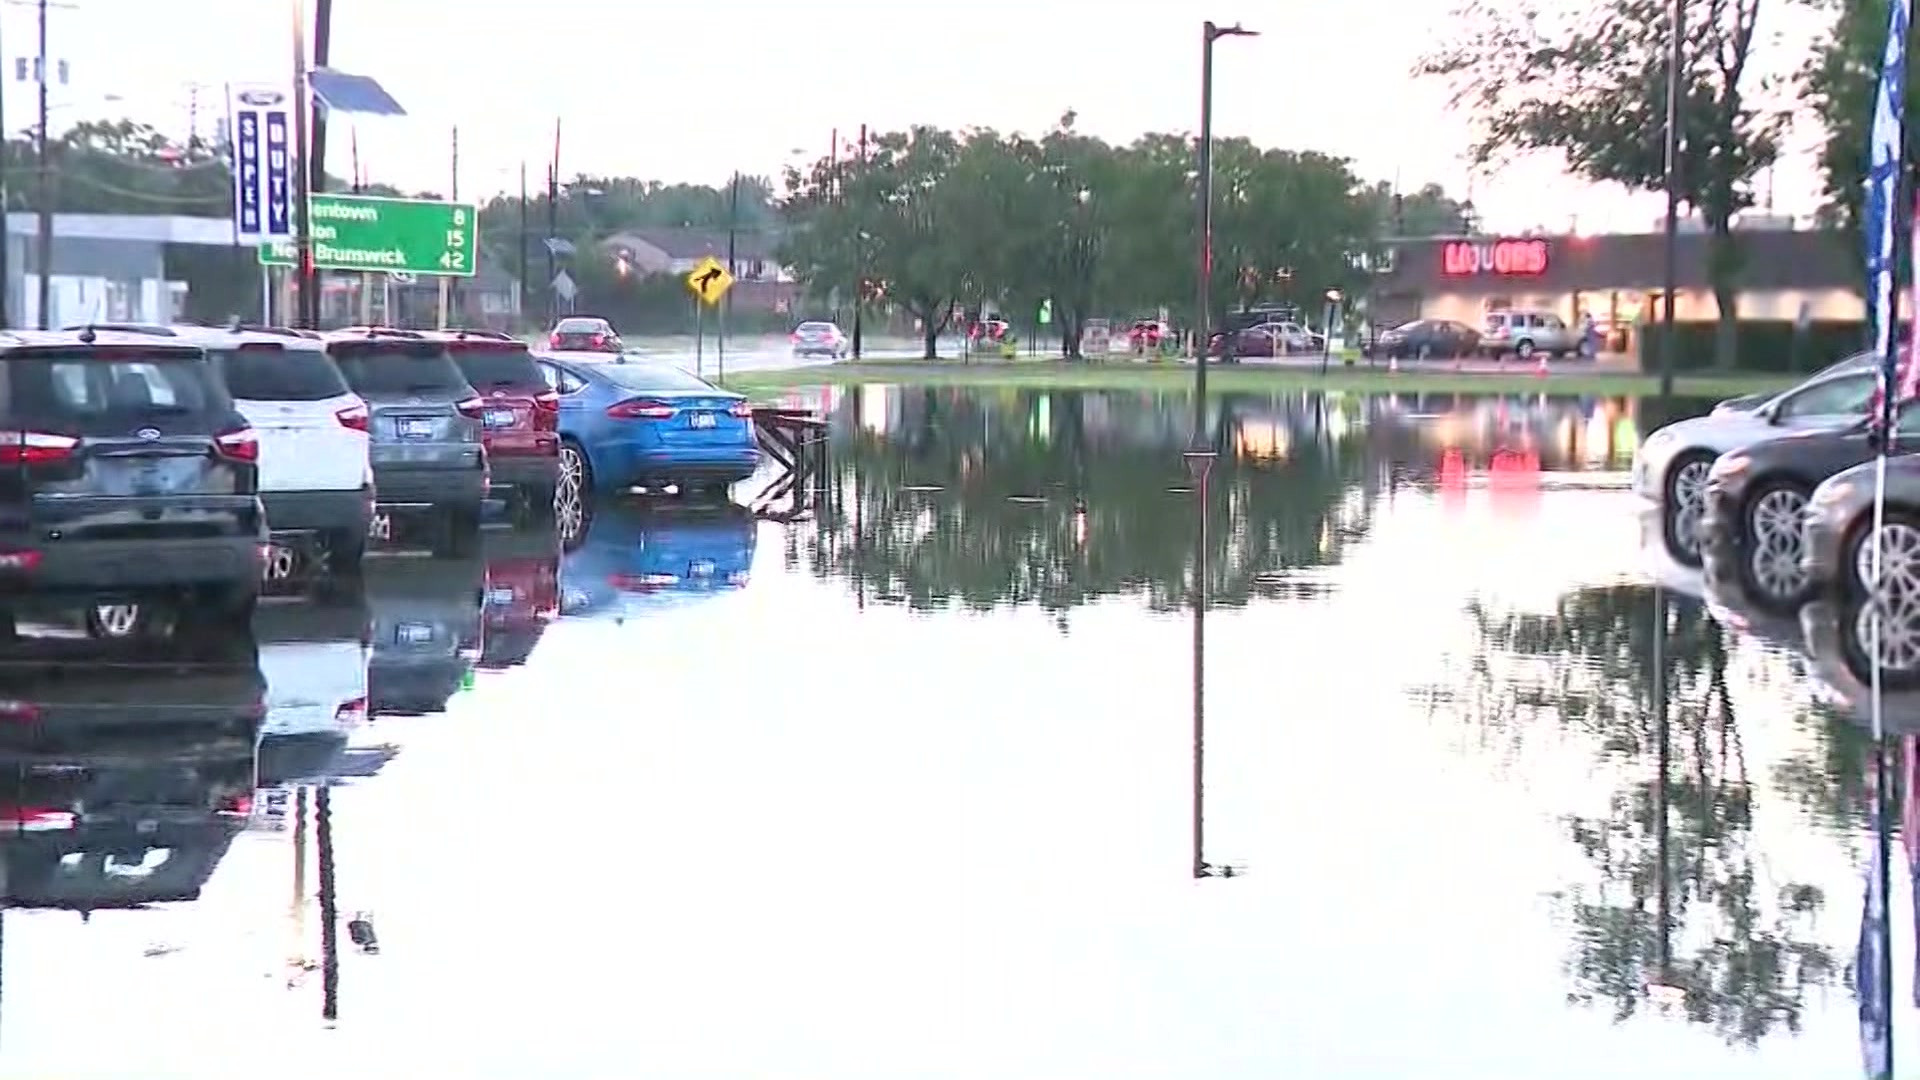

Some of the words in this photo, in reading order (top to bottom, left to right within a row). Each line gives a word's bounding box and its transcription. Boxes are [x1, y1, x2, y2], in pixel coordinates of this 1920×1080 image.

[242, 118, 257, 226] SUPER
[270, 123, 285, 222] DUTY
[312, 202, 378, 221] entown
[453, 208, 465, 226] 8
[309, 222, 337, 240] ton
[446, 229, 465, 248] 15
[271, 243, 299, 259] Ne
[315, 243, 407, 266] Brunswick
[440, 251, 465, 270] 42
[1444, 241, 1548, 273] LIQUORS
